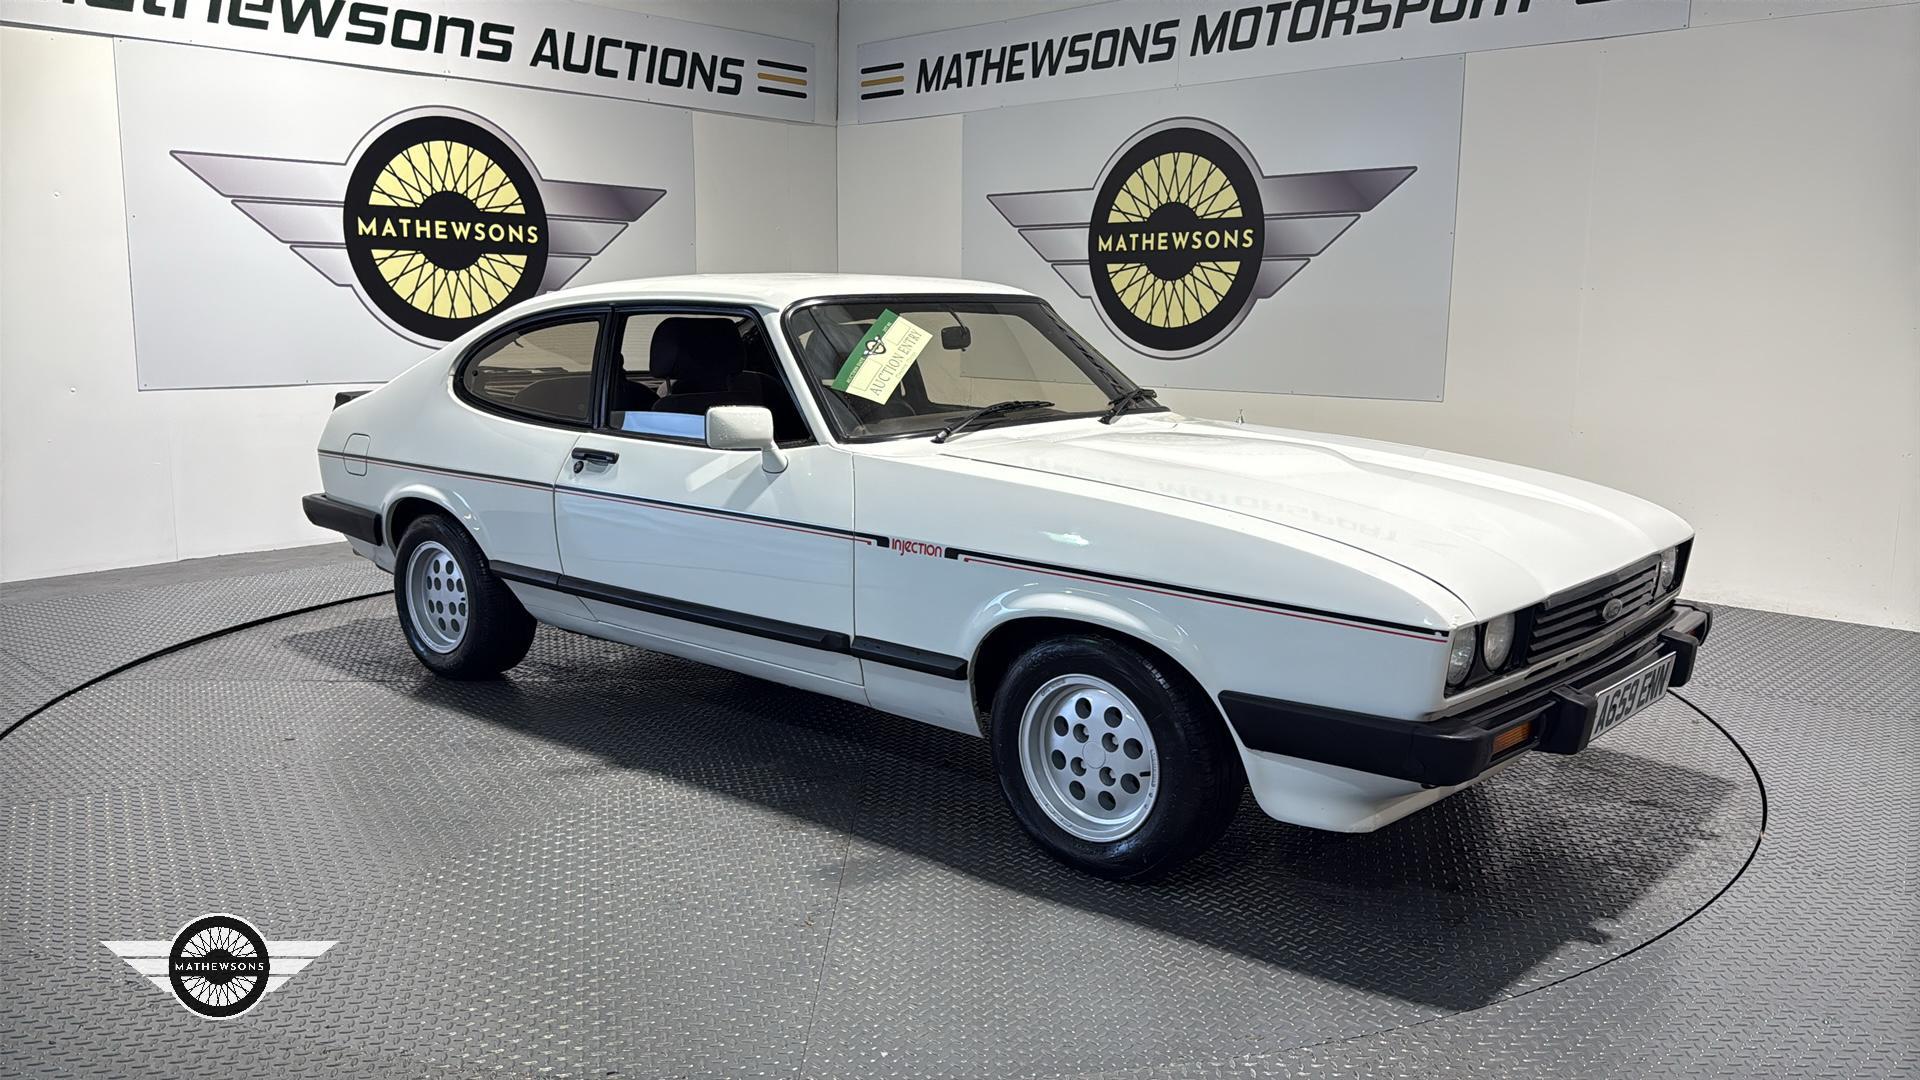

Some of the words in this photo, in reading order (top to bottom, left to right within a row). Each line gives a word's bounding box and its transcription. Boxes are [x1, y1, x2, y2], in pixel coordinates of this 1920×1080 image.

[529, 27, 745, 96] AUCTIONS
[915, 18, 1181, 94] MATHEWSONS
[357, 216, 539, 244] MATHEWSONS
[1098, 229, 1254, 252] MATHEWSONS
[870, 353, 905, 397] AUCTION
[897, 328, 923, 355] ENTRY
[1594, 678, 1640, 734] A659
